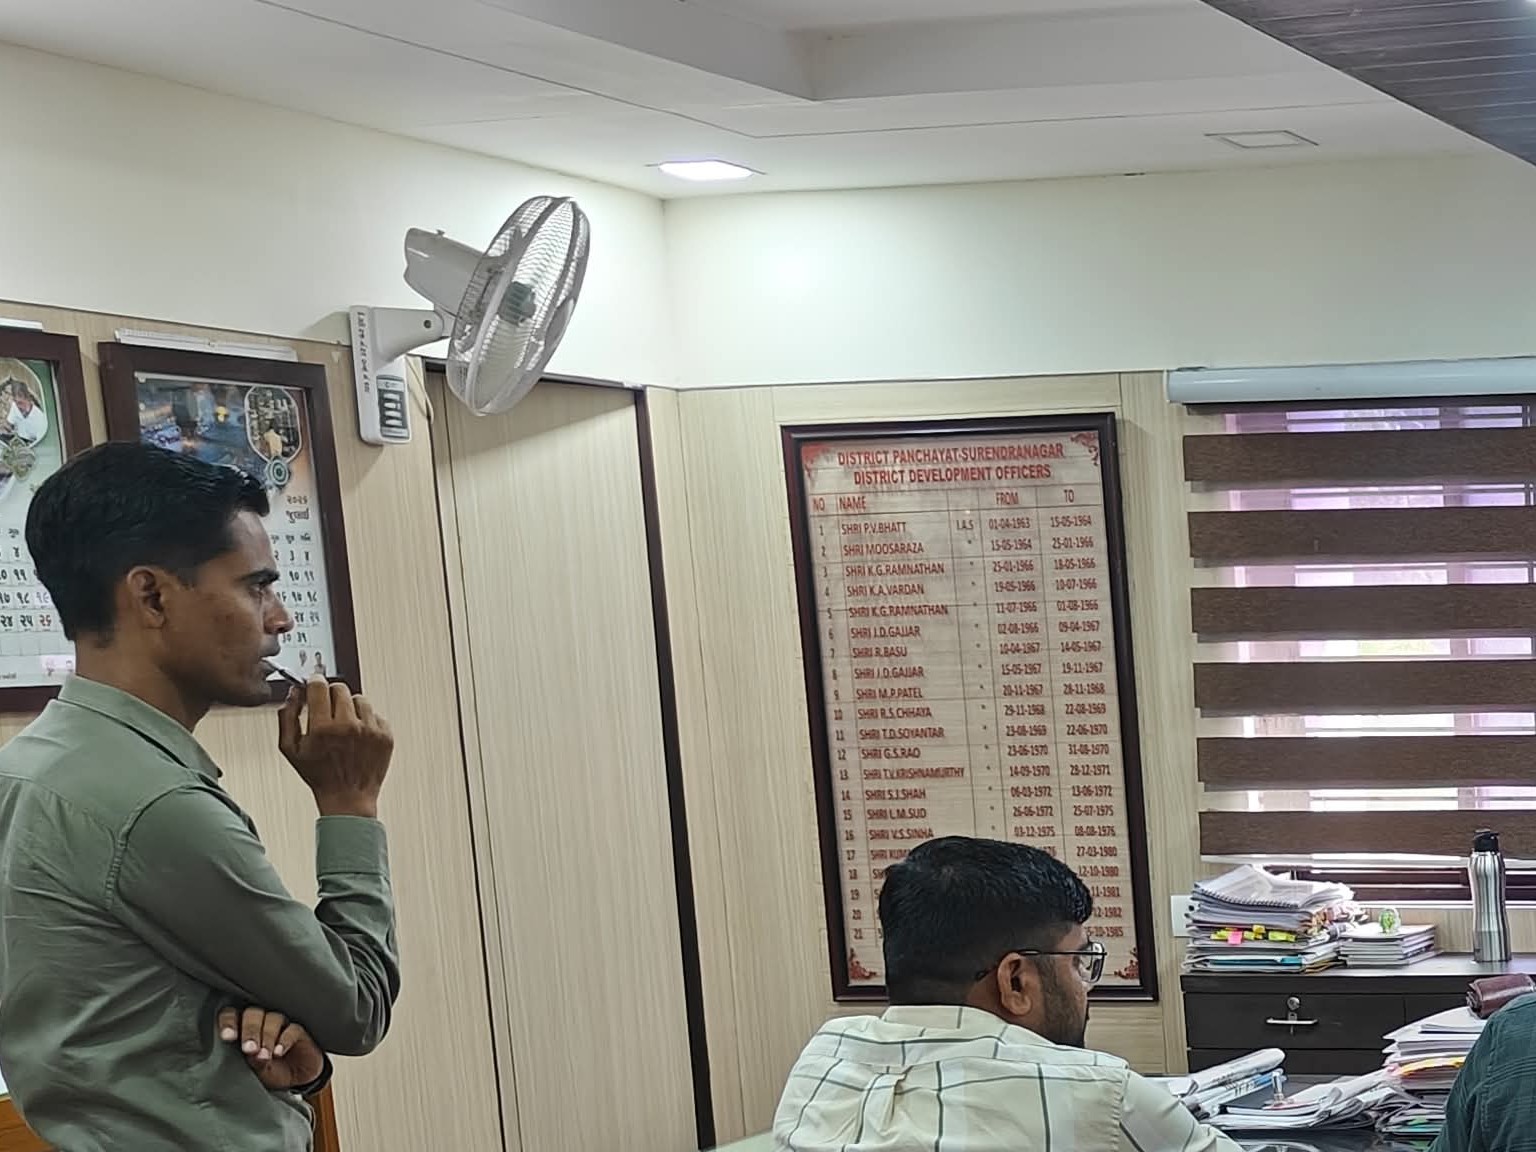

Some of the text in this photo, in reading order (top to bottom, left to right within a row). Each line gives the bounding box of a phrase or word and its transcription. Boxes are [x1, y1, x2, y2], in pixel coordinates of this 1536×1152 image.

[838, 443, 1064, 465] DISTRICT PANCHAYAT-SURENDRANAGAR
[854, 464, 1051, 485] DISTRICT DEVELOPMENT OFFICERS
[839, 496, 866, 510] NAME
[996, 492, 1019, 505] FROM
[1063, 489, 1074, 503] TO
[842, 523, 861, 535] SHRI
[864, 521, 906, 534] P.V.BHATT
[989, 517, 1031, 530] 01-04-1963
[844, 544, 863, 556] SHRI
[866, 542, 924, 556] MOOSARAZA
[846, 564, 944, 577] SHRI K.G.RAMNATHAN
[847, 584, 924, 597] SHRI K.A.VARDAN
[849, 607, 869, 618] SHRI
[851, 628, 871, 639] SHRI
[852, 648, 872, 658] SHRI
[854, 668, 874, 679] SHRI
[856, 688, 876, 700] SHRI
[858, 708, 878, 719] SHRI
[860, 729, 880, 740] SHRI
[862, 748, 881, 760] SHRI
[864, 769, 881, 780] SHRI
[865, 790, 886, 800] SHRI
[867, 809, 887, 820] SHRI
[869, 829, 889, 840] SHRI
[871, 850, 889, 860] SHRI
